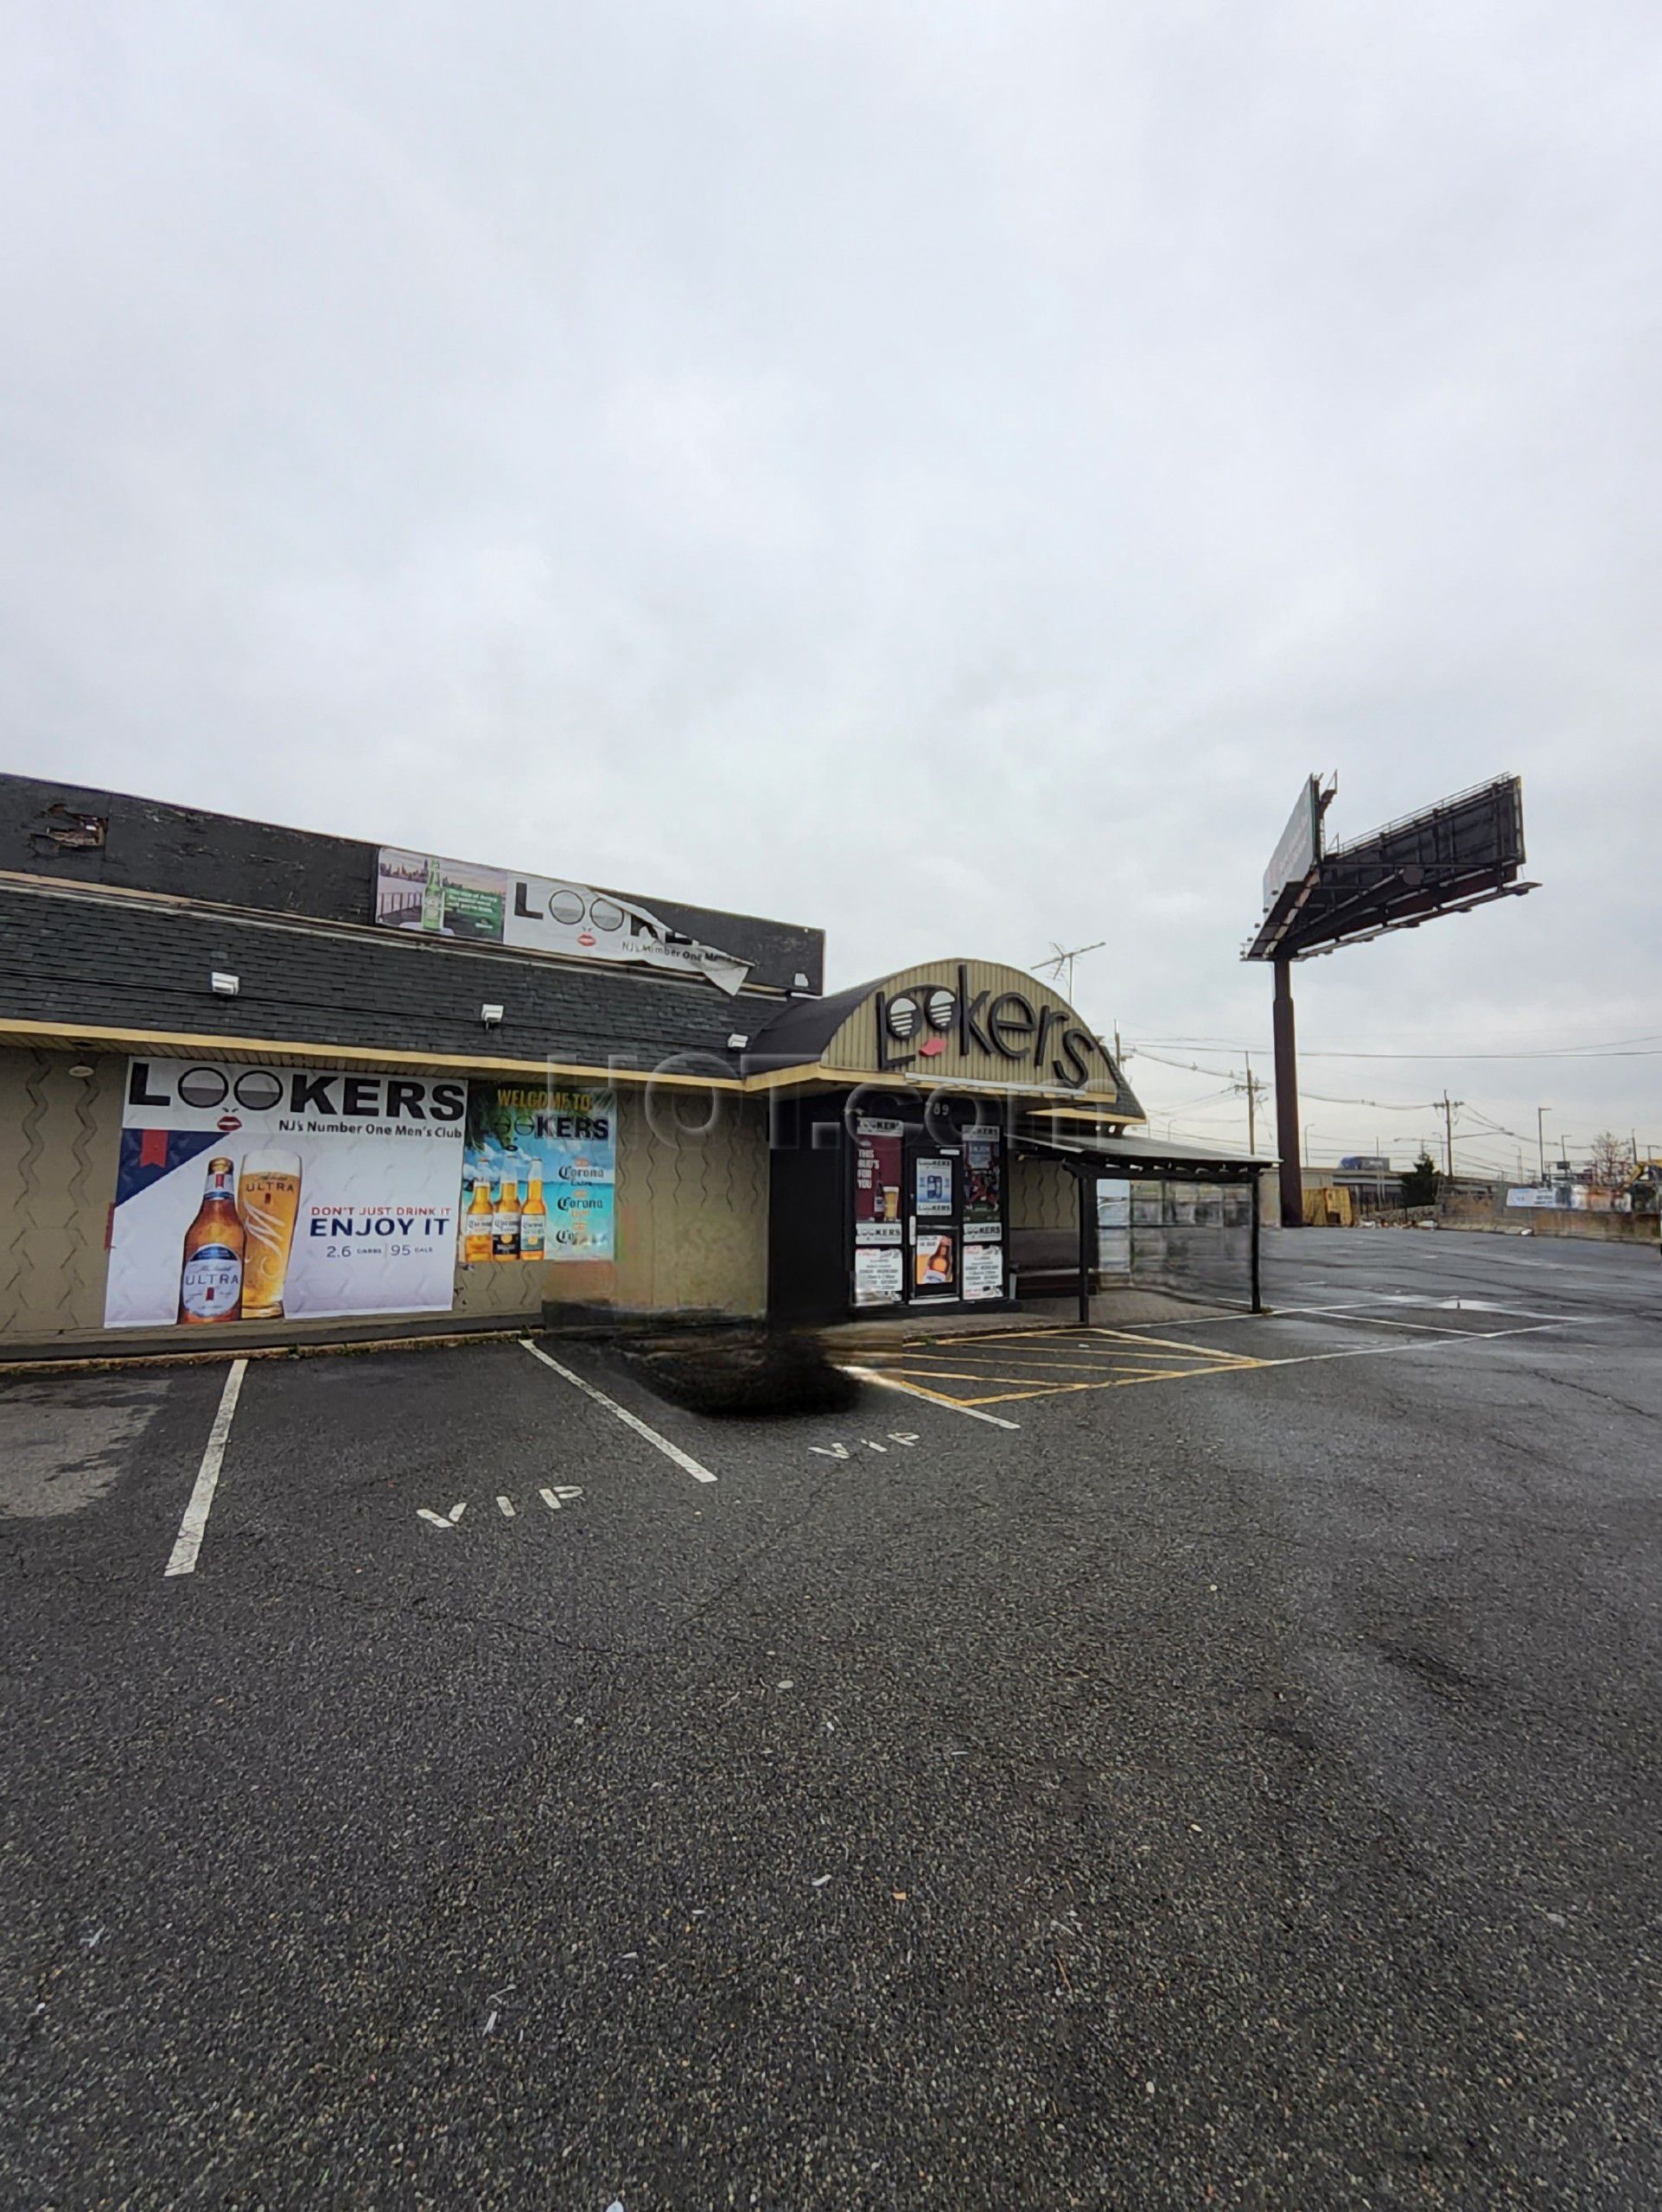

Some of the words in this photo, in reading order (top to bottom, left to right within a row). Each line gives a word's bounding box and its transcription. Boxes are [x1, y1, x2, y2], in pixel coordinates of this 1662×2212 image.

[129, 1061, 465, 1122] LOOKERS
[278, 1119, 303, 1133] NJ's
[307, 1121, 363, 1135] Number
[366, 1123, 392, 1136] One
[395, 1125, 432, 1137] Men's
[434, 1126, 462, 1139] Club
[558, 1166, 604, 1180] Corona
[246, 1182, 295, 1193] ULTRA
[311, 1206, 355, 1216] DON'T
[359, 1206, 392, 1216] JUST
[396, 1206, 436, 1216] DRINK
[557, 1196, 604, 1211] Corona
[309, 1217, 415, 1237] ENJOY
[424, 1217, 450, 1236] IT
[326, 1245, 352, 1259] 2.6
[391, 1244, 411, 1256] 95
[185, 1274, 239, 1286] ULTRA
